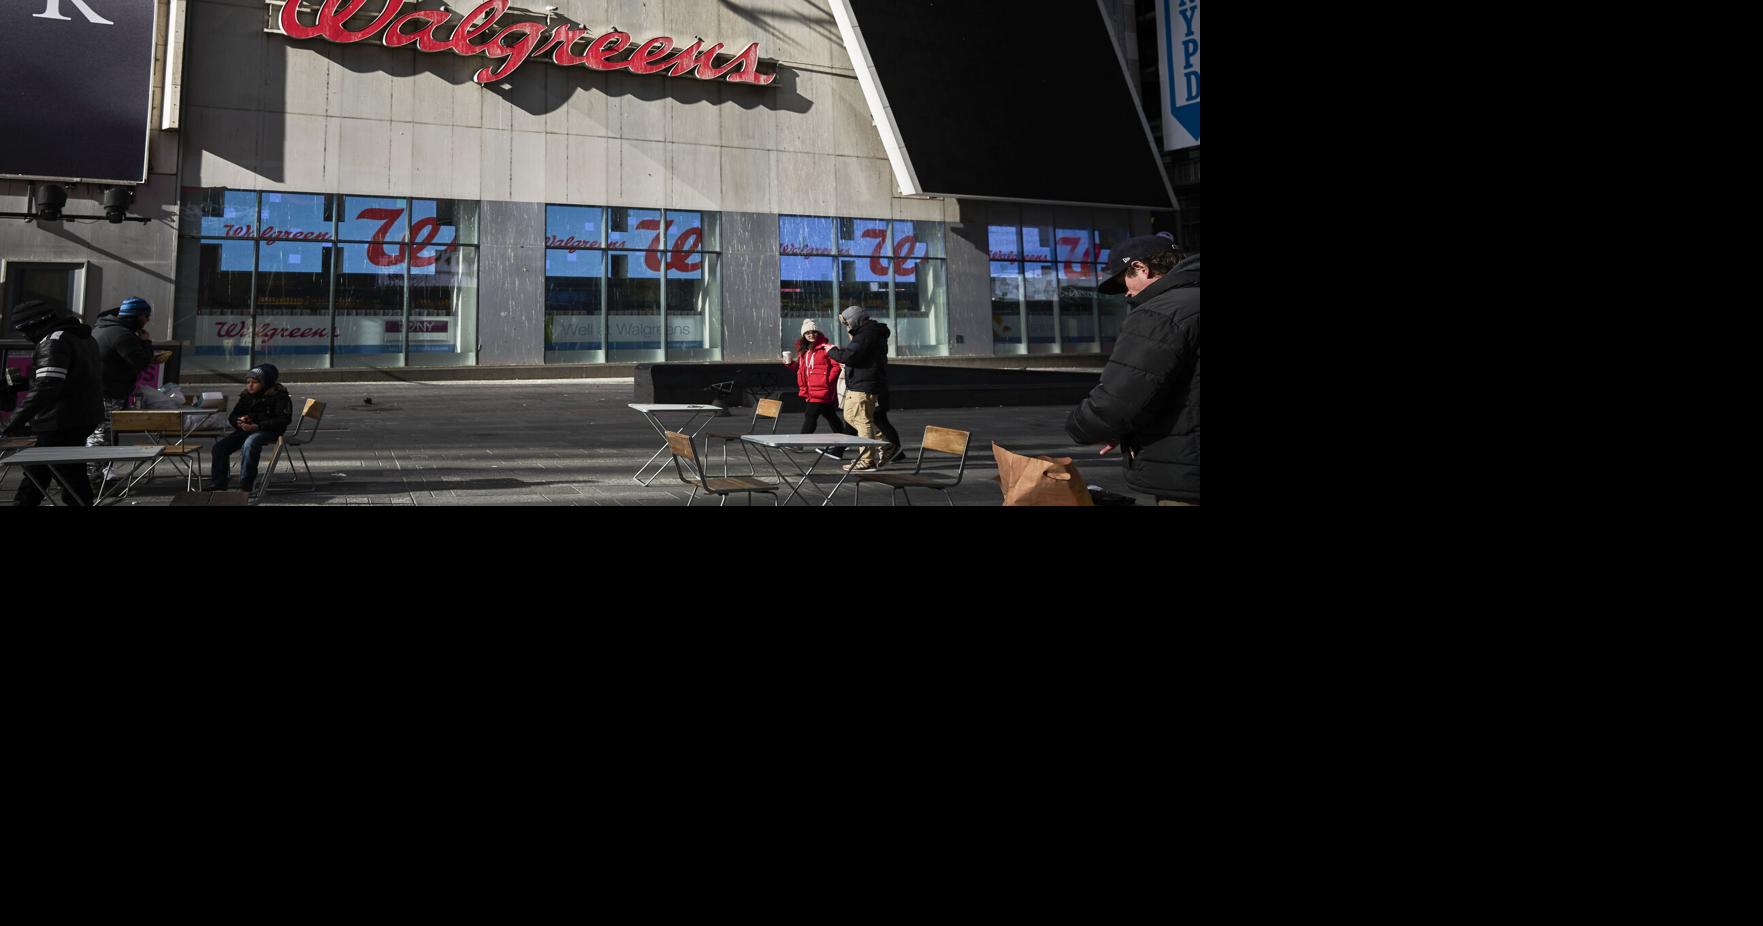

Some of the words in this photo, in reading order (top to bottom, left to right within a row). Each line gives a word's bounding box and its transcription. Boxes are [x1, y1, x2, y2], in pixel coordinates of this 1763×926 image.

[279, 0, 777, 86] Walgreens
[1178, 0, 1200, 102] YPD
[224, 223, 334, 246] Wlgreen
[545, 235, 626, 254] Walgrens
[561, 322, 594, 337] Well
